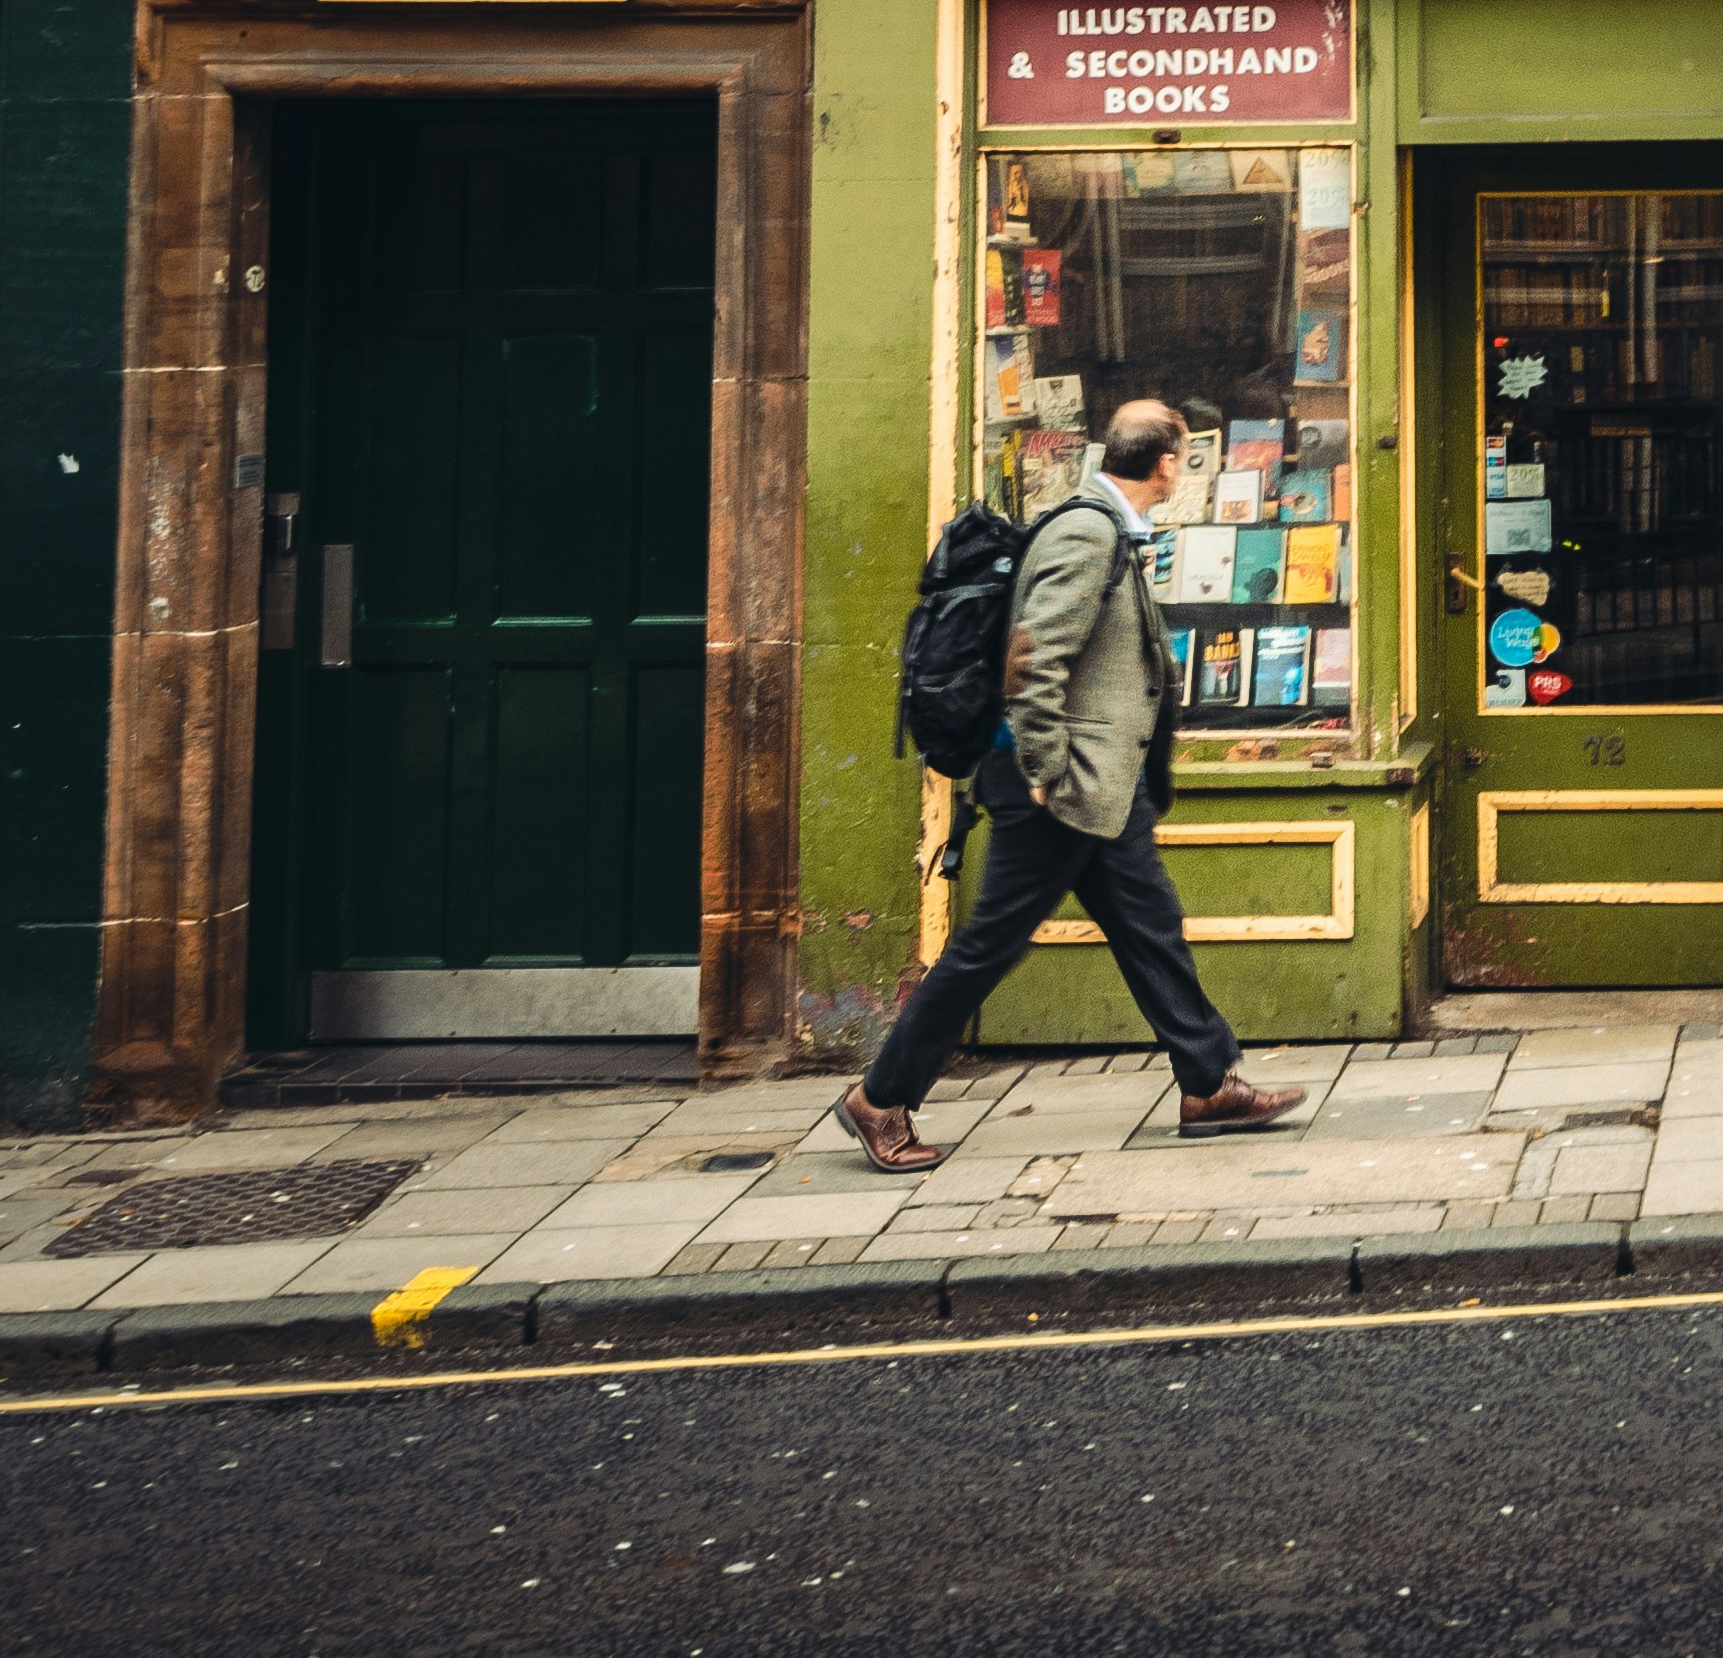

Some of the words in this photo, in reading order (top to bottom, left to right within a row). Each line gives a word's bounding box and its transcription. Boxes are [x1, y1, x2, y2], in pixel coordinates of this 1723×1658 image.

[1056, 5, 1277, 36] ILLUSTRATED
[1007, 51, 1036, 79] &
[1064, 45, 1320, 79] SECONDHAND
[1103, 84, 1231, 115] BOOKS
[1583, 734, 1627, 767] 72
